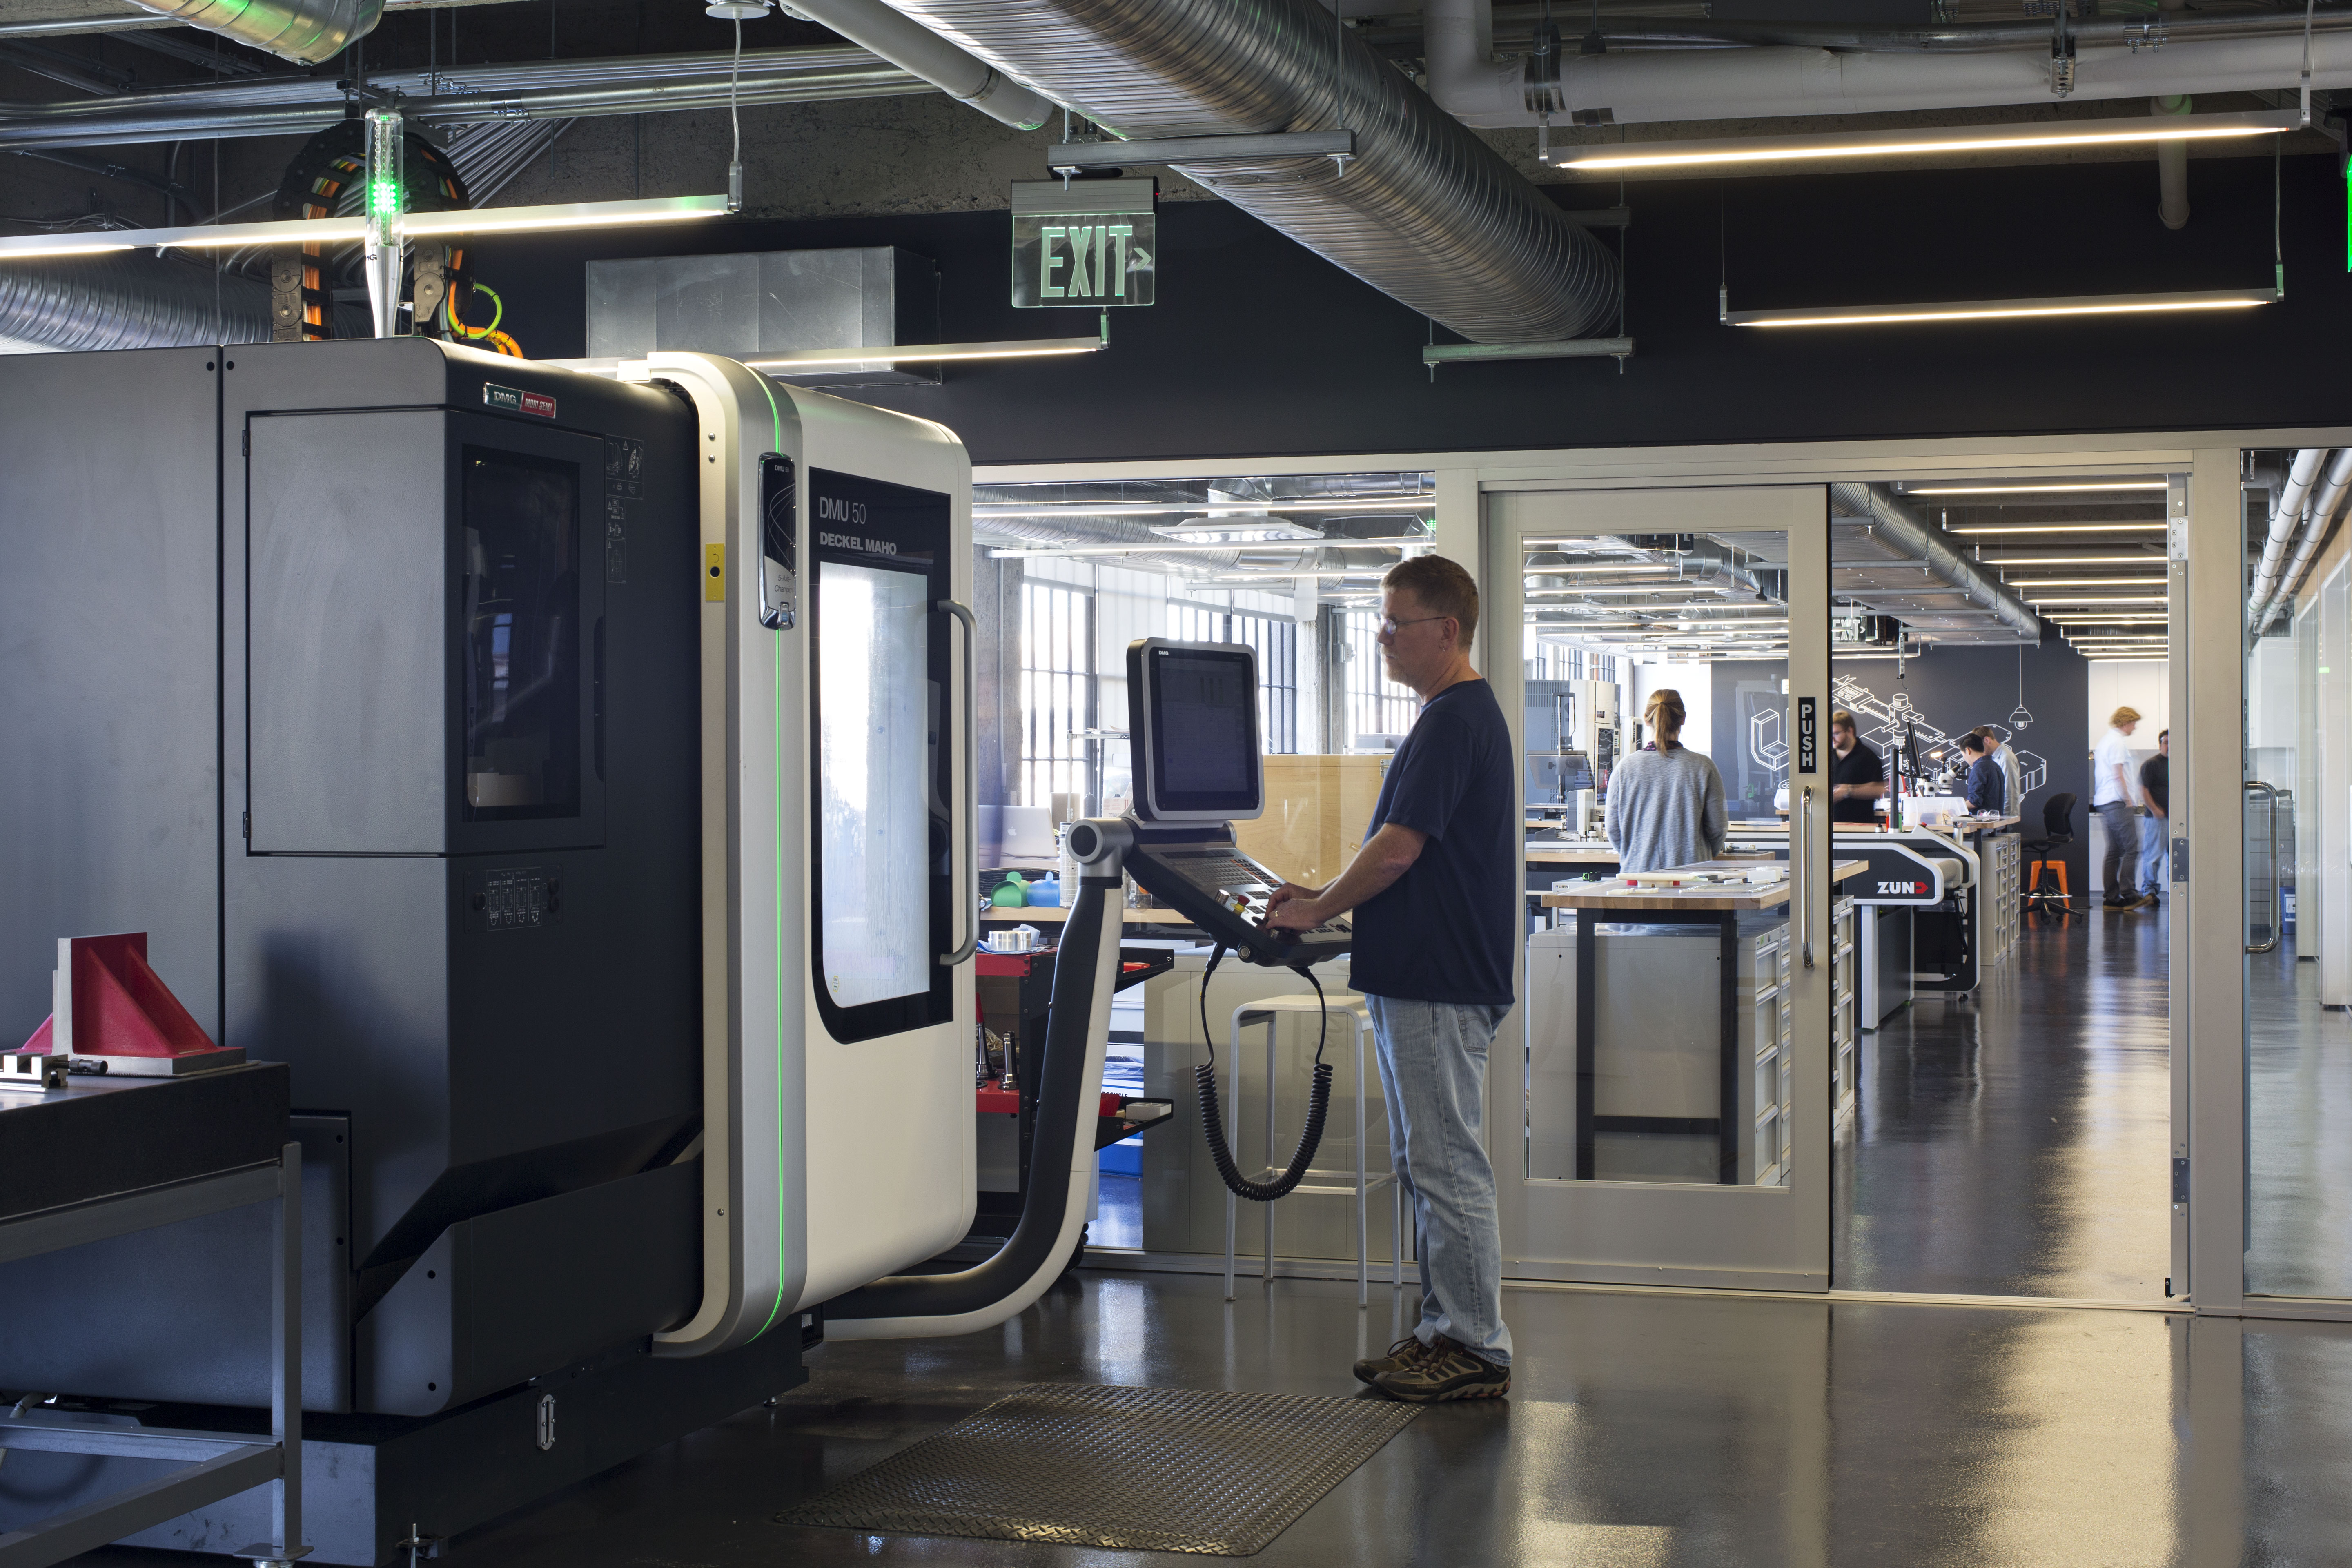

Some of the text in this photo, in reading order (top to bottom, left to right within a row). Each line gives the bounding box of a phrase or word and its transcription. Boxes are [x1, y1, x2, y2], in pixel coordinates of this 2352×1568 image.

[1041, 225, 1133, 297] EXIT
[494, 391, 517, 404] DMG
[524, 398, 552, 412] MORI SEIKI
[820, 496, 866, 524] DMU 50
[820, 532, 897, 555] DECKEL MAHO
[775, 585, 793, 595] Champion
[1802, 704, 1813, 766] PUSH
[1877, 881, 1929, 894] ZÜND
